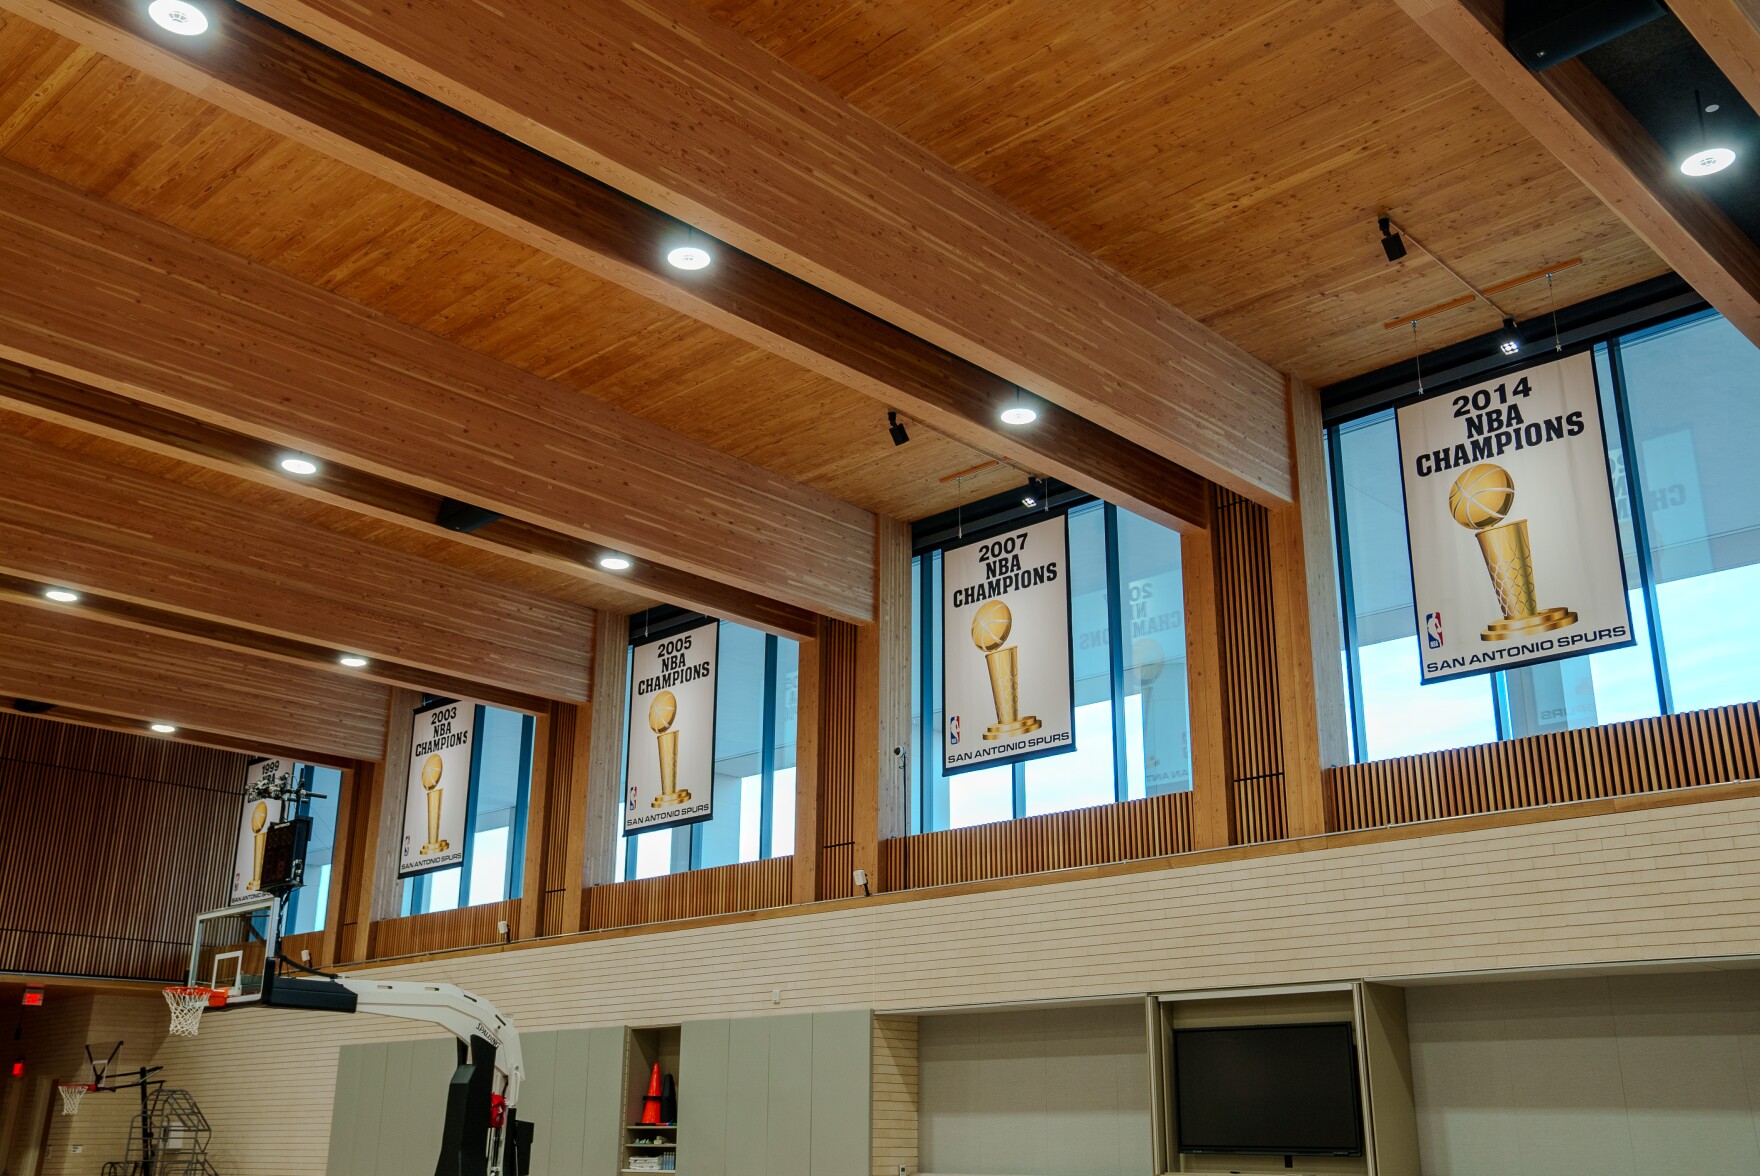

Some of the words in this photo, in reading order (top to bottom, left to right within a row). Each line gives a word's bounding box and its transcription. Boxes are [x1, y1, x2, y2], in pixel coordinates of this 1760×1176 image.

[1452, 376, 1532, 418] 2014
[1465, 403, 1524, 439] NBA
[1416, 411, 1585, 477] CHAMPIONS
[978, 532, 1028, 562] 2007
[985, 554, 1021, 580] NBA
[953, 562, 1058, 608] CHAMPIONS
[657, 635, 692, 658] 2005
[1426, 656, 1466, 673] SAN
[1468, 639, 1554, 665] ANTONIO
[1557, 625, 1627, 648] SPURS
[661, 653, 686, 673] NBA
[638, 661, 710, 695] CHAMPIONS
[431, 707, 457, 725] 2003
[415, 730, 468, 757] CHAMPIONS
[433, 721, 451, 739] NBA
[948, 751, 972, 764] SAN
[974, 740, 1026, 758] ANTONIO
[1028, 732, 1070, 747] SPURS
[262, 760, 280, 775] 1999
[626, 816, 644, 827] SAN
[644, 809, 680, 823] ANTONIO
[681, 803, 709, 815] SPURS
[401, 861, 414, 870] SAN
[413, 856, 441, 868] ANTONIO
[441, 852, 462, 863] SPURS
